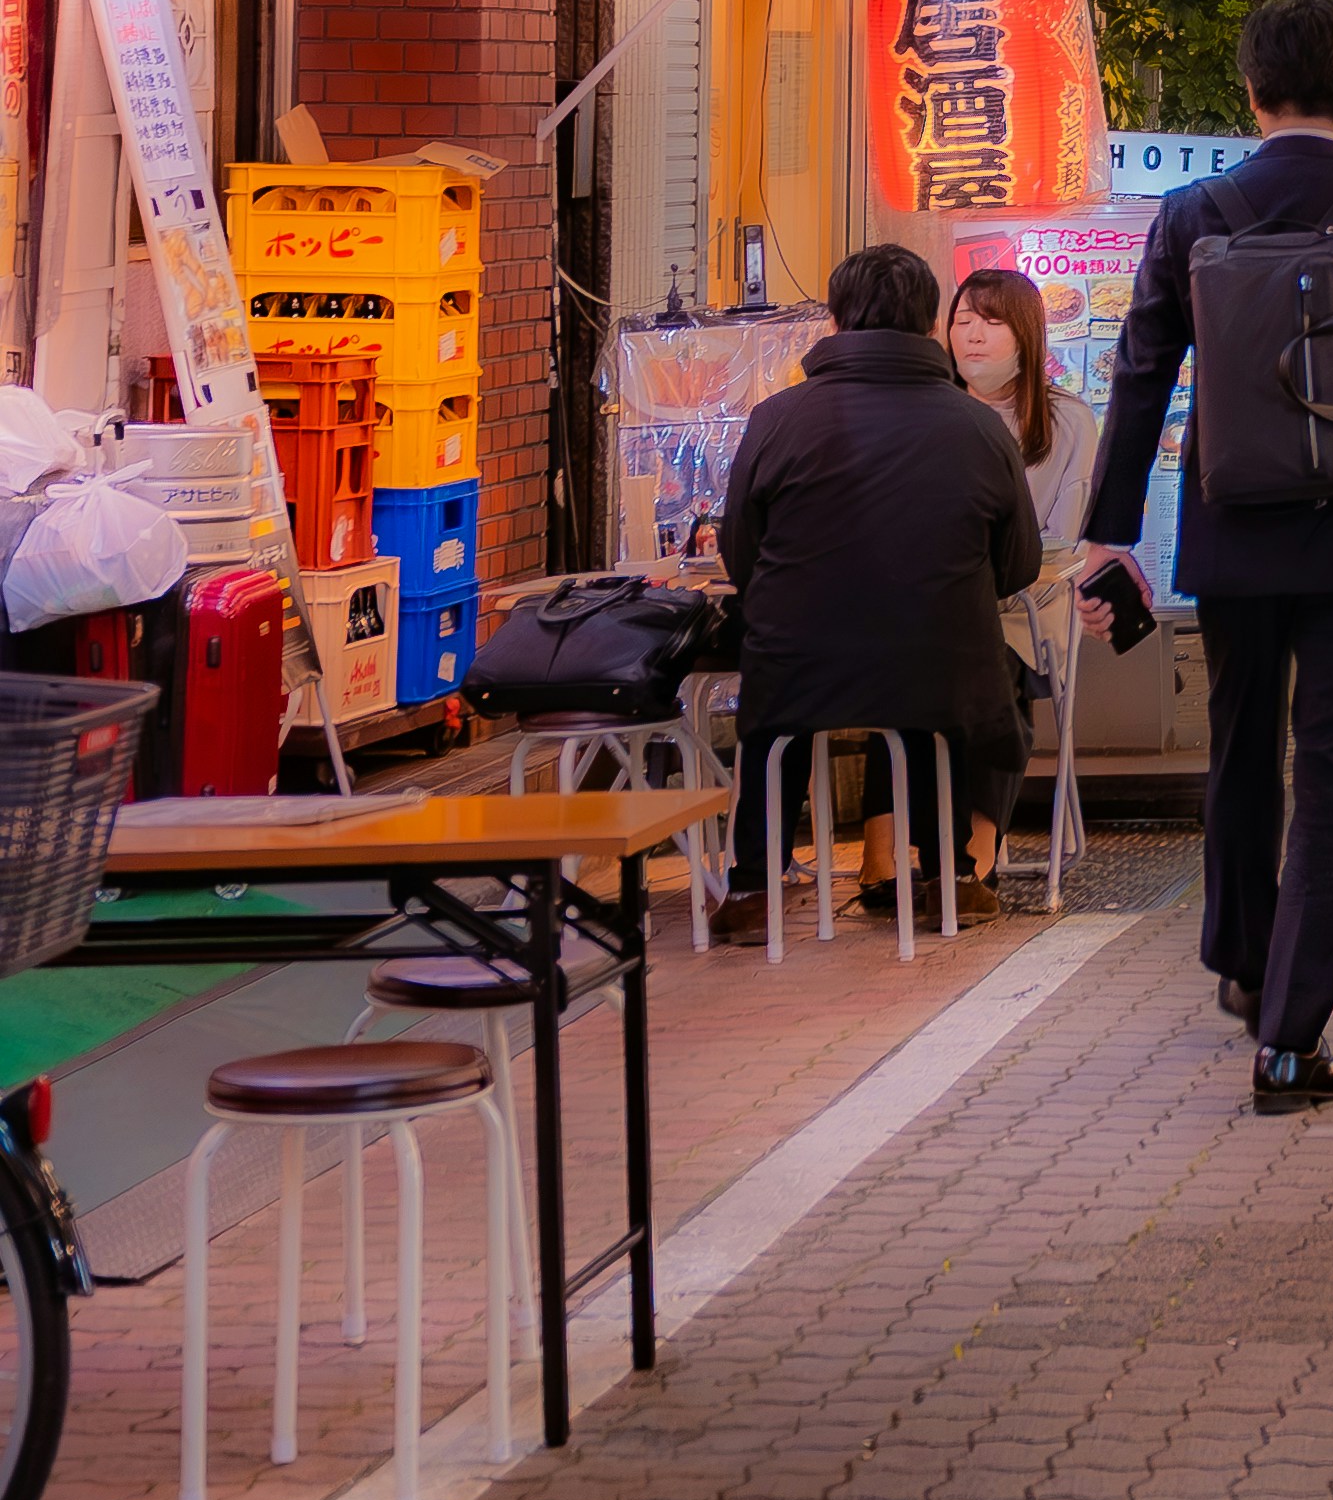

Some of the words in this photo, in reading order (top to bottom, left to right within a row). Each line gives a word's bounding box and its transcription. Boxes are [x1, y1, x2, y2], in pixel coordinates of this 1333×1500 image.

[1110, 144, 1250, 173] HOTE
[265, 227, 383, 258] ホッピー
[1022, 255, 1138, 276] 100種類以上
